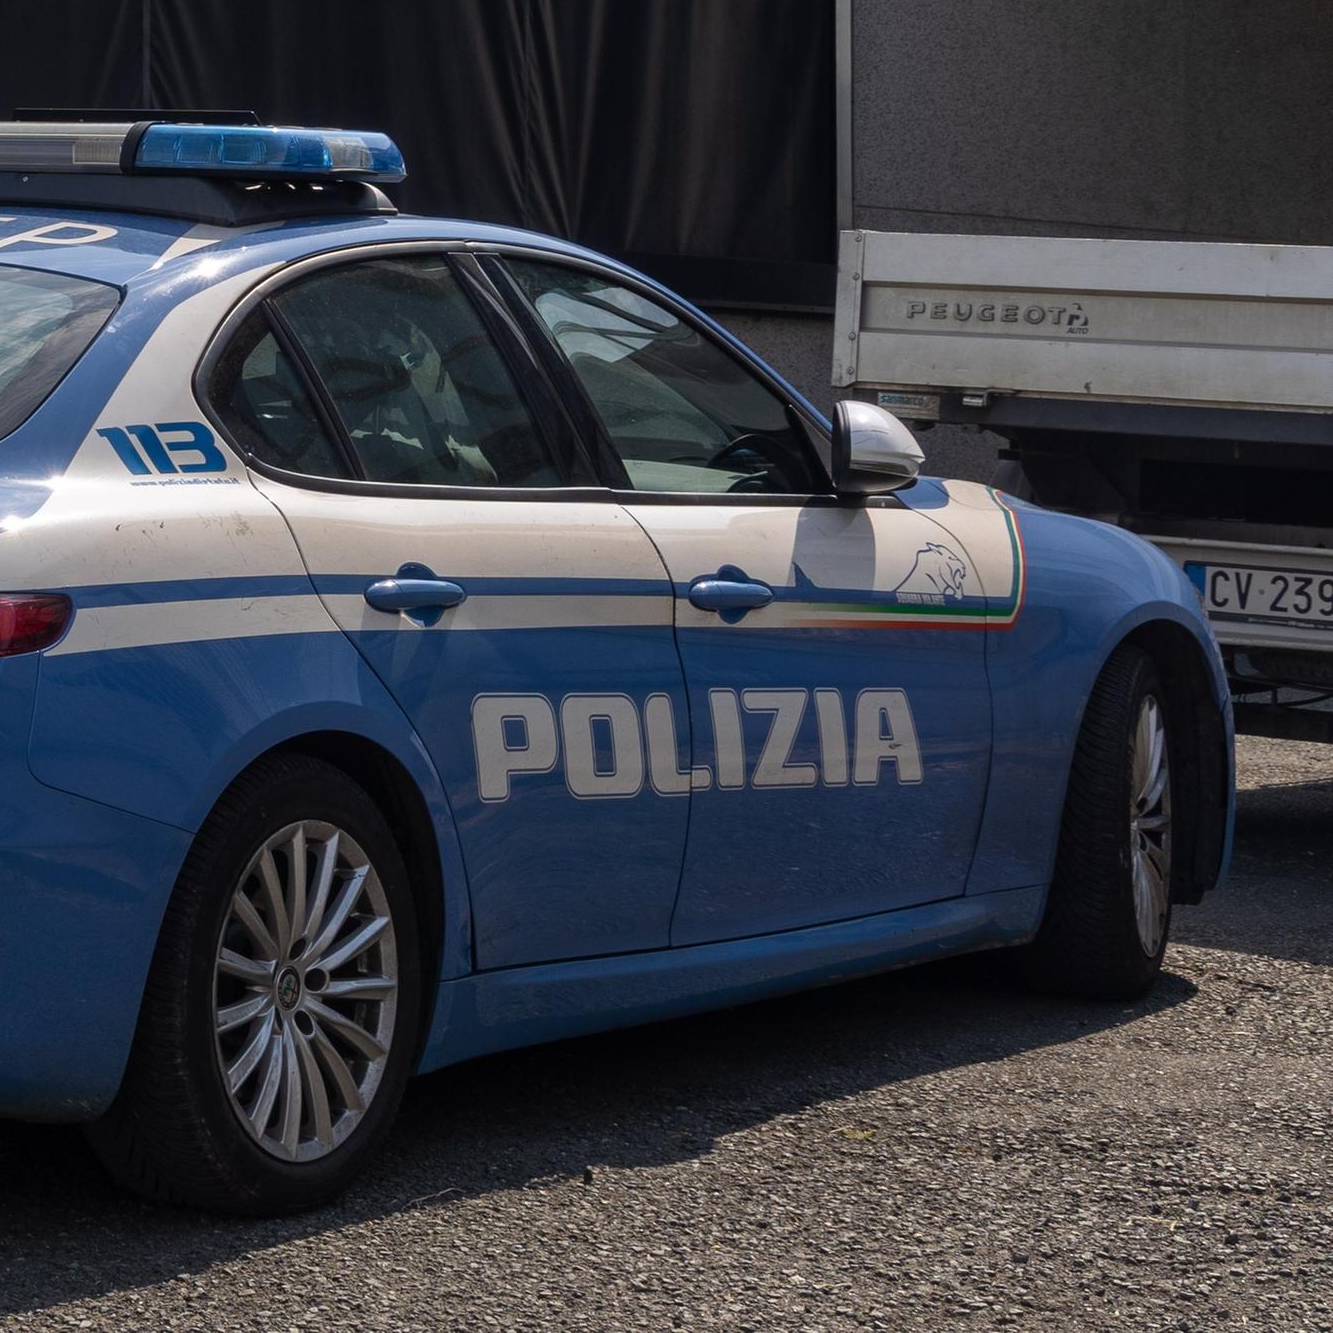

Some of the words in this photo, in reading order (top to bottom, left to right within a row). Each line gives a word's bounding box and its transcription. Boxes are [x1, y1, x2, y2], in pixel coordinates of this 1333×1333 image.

[906, 300, 1066, 325] PEUGEOT
[95, 421, 228, 476] 113
[1210, 570, 1253, 610] CV
[1269, 575, 1333, 616] 239
[471, 687, 925, 804] POLIZIA
